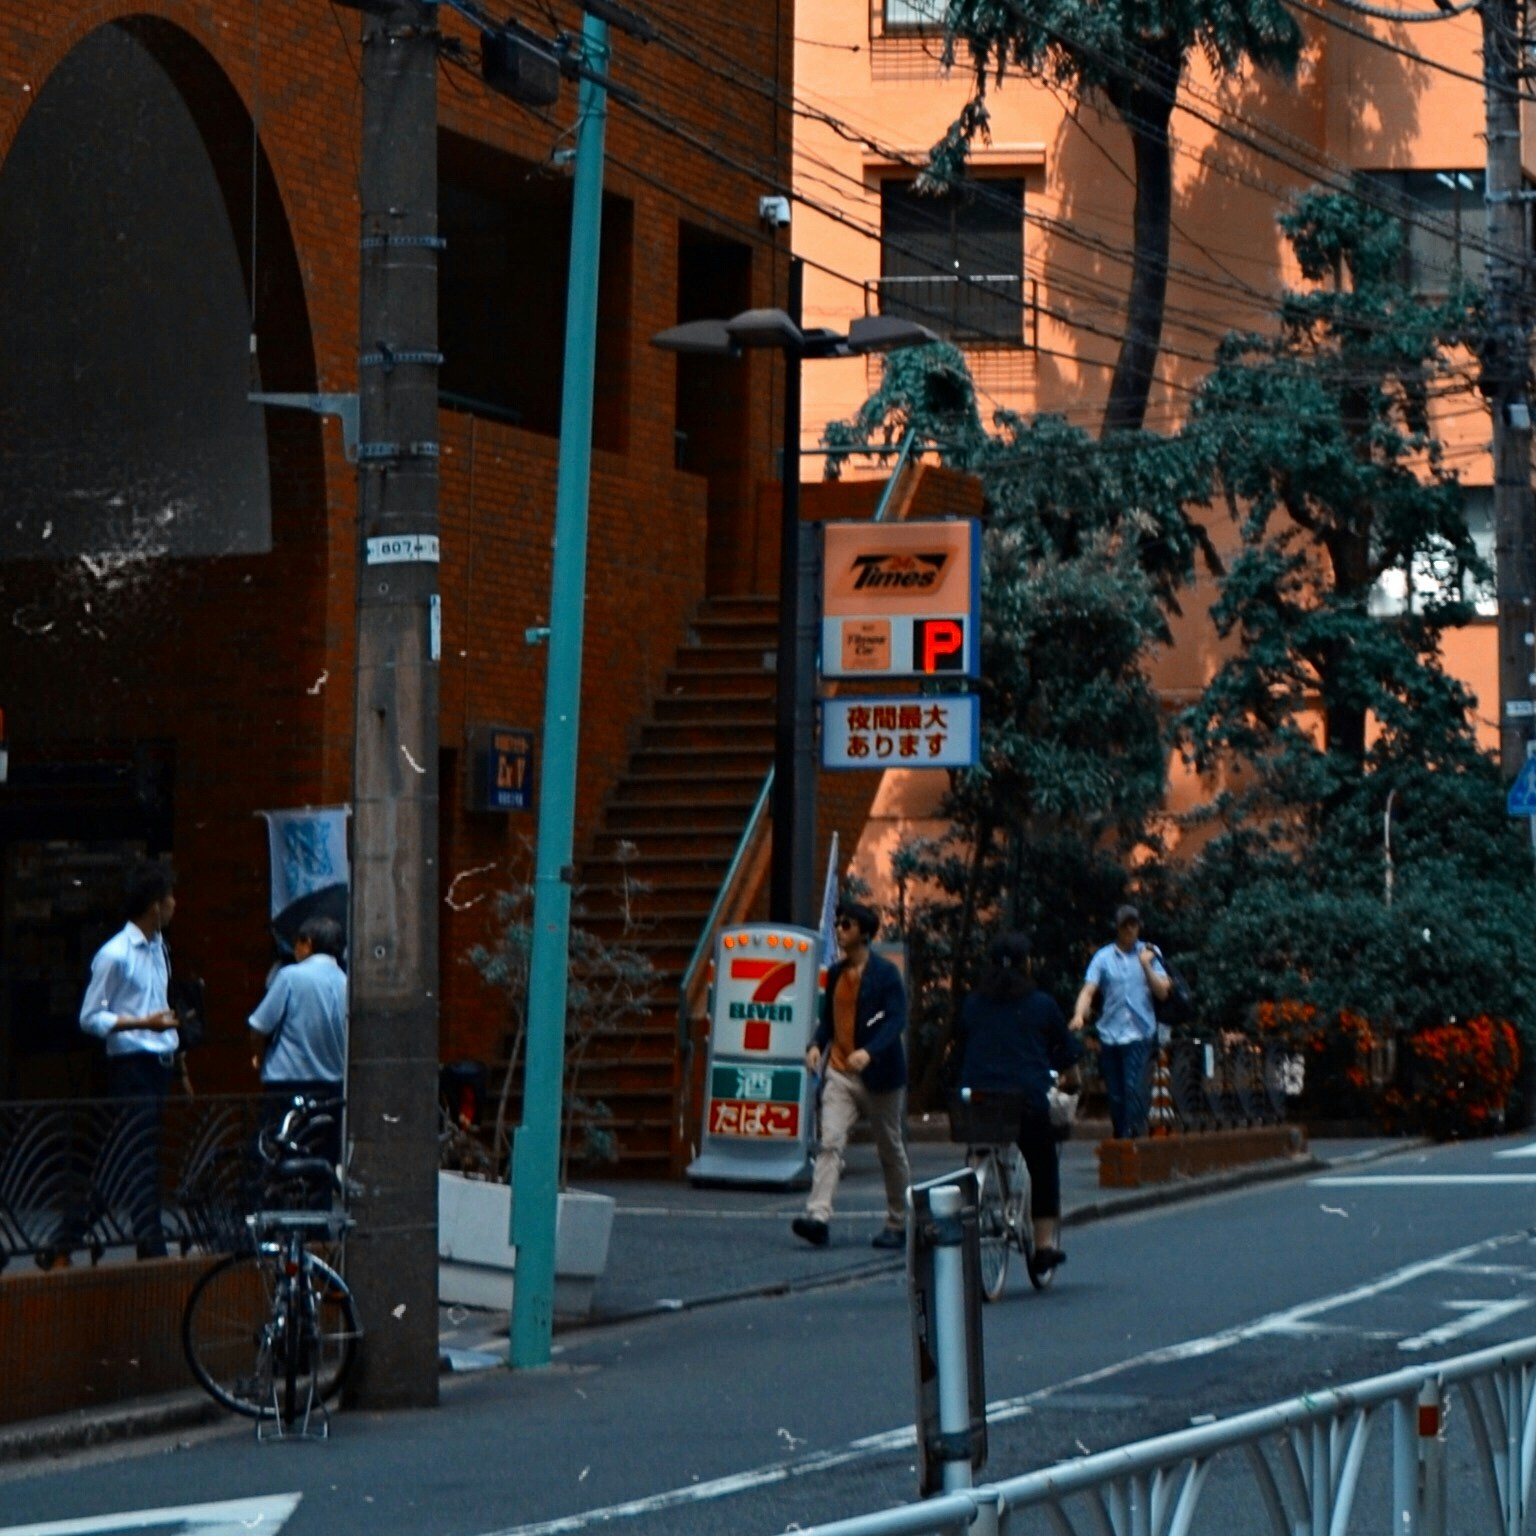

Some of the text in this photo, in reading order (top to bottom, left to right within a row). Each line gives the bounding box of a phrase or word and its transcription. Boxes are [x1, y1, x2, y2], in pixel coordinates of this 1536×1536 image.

[381, 540, 412, 557] 807
[852, 554, 947, 590] Times
[923, 620, 964, 674] P
[847, 704, 948, 731] 夜間最大
[847, 732, 948, 759] あります
[730, 958, 797, 1051] 7
[735, 1067, 774, 1100] 酒
[714, 1103, 792, 1136] たばこ
